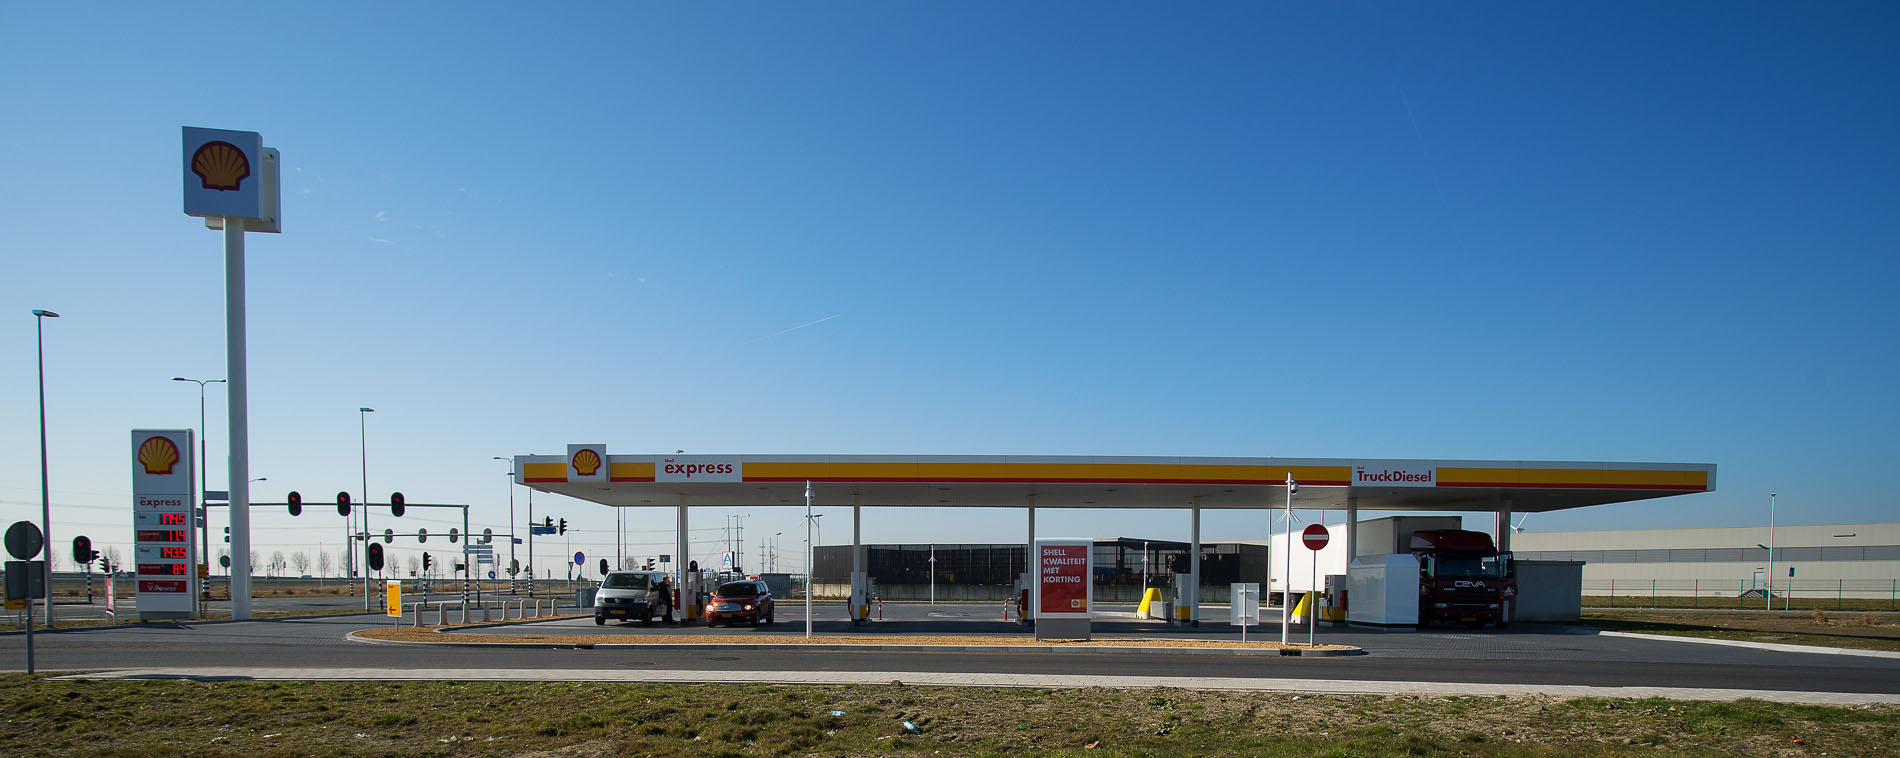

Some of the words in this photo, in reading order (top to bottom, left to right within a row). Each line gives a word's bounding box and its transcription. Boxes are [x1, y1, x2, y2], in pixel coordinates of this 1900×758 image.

[665, 463, 732, 478] express
[1356, 469, 1431, 482] TruckDiesel
[140, 499, 182, 508] express
[1455, 580, 1486, 588] CEVA
